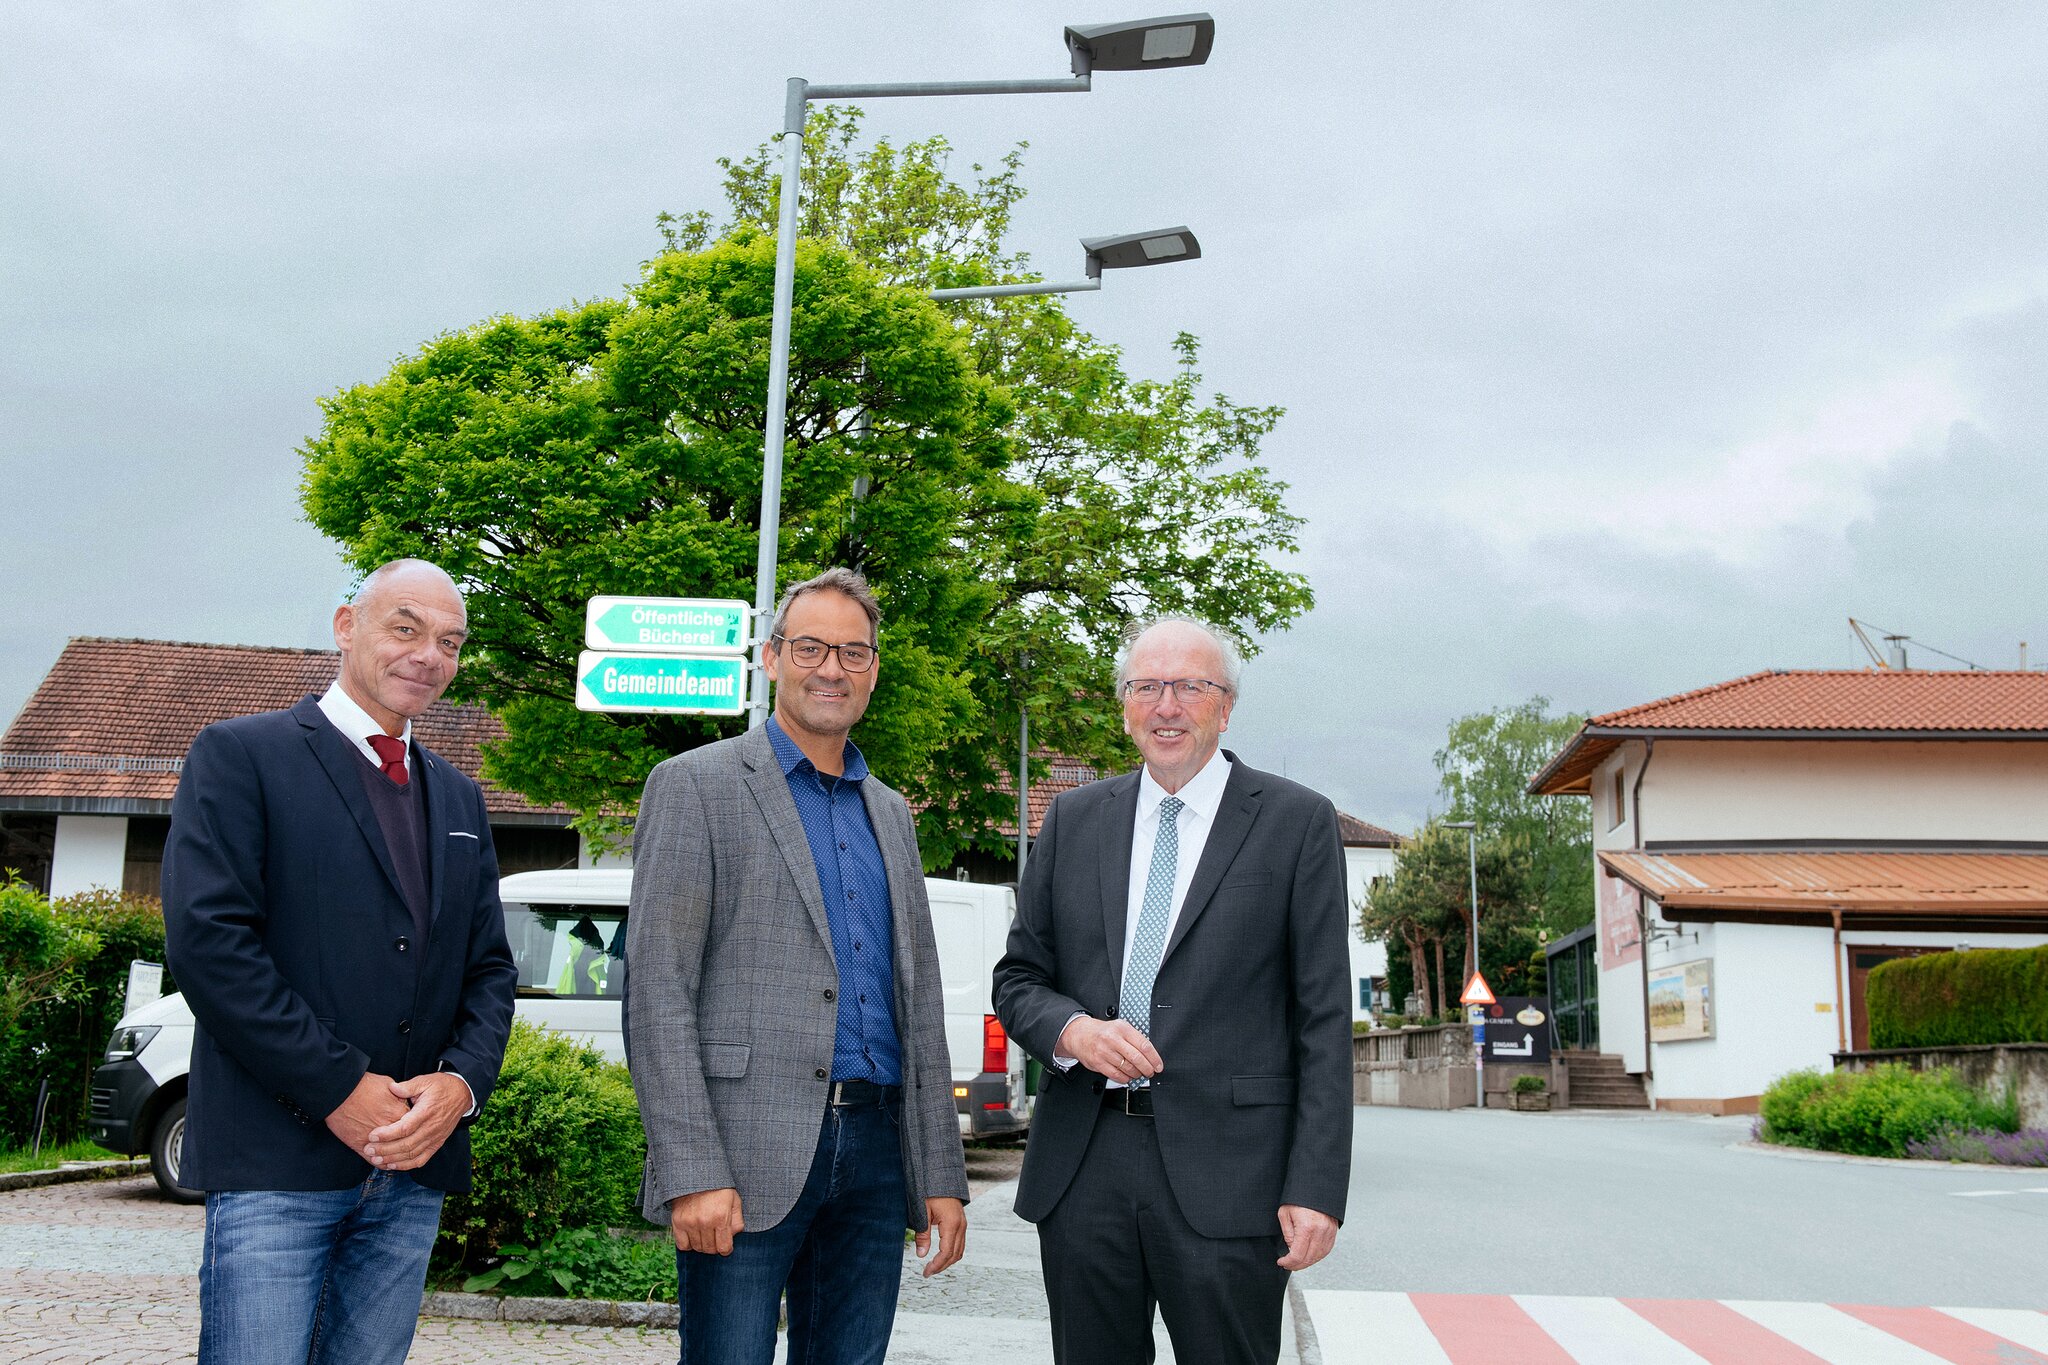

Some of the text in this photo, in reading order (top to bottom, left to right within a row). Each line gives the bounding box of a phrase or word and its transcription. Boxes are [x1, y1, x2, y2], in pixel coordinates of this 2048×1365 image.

[632, 606, 724, 626] Öffentliche
[639, 628, 714, 645] Bücherei
[604, 667, 734, 696] Gemeindeamt
